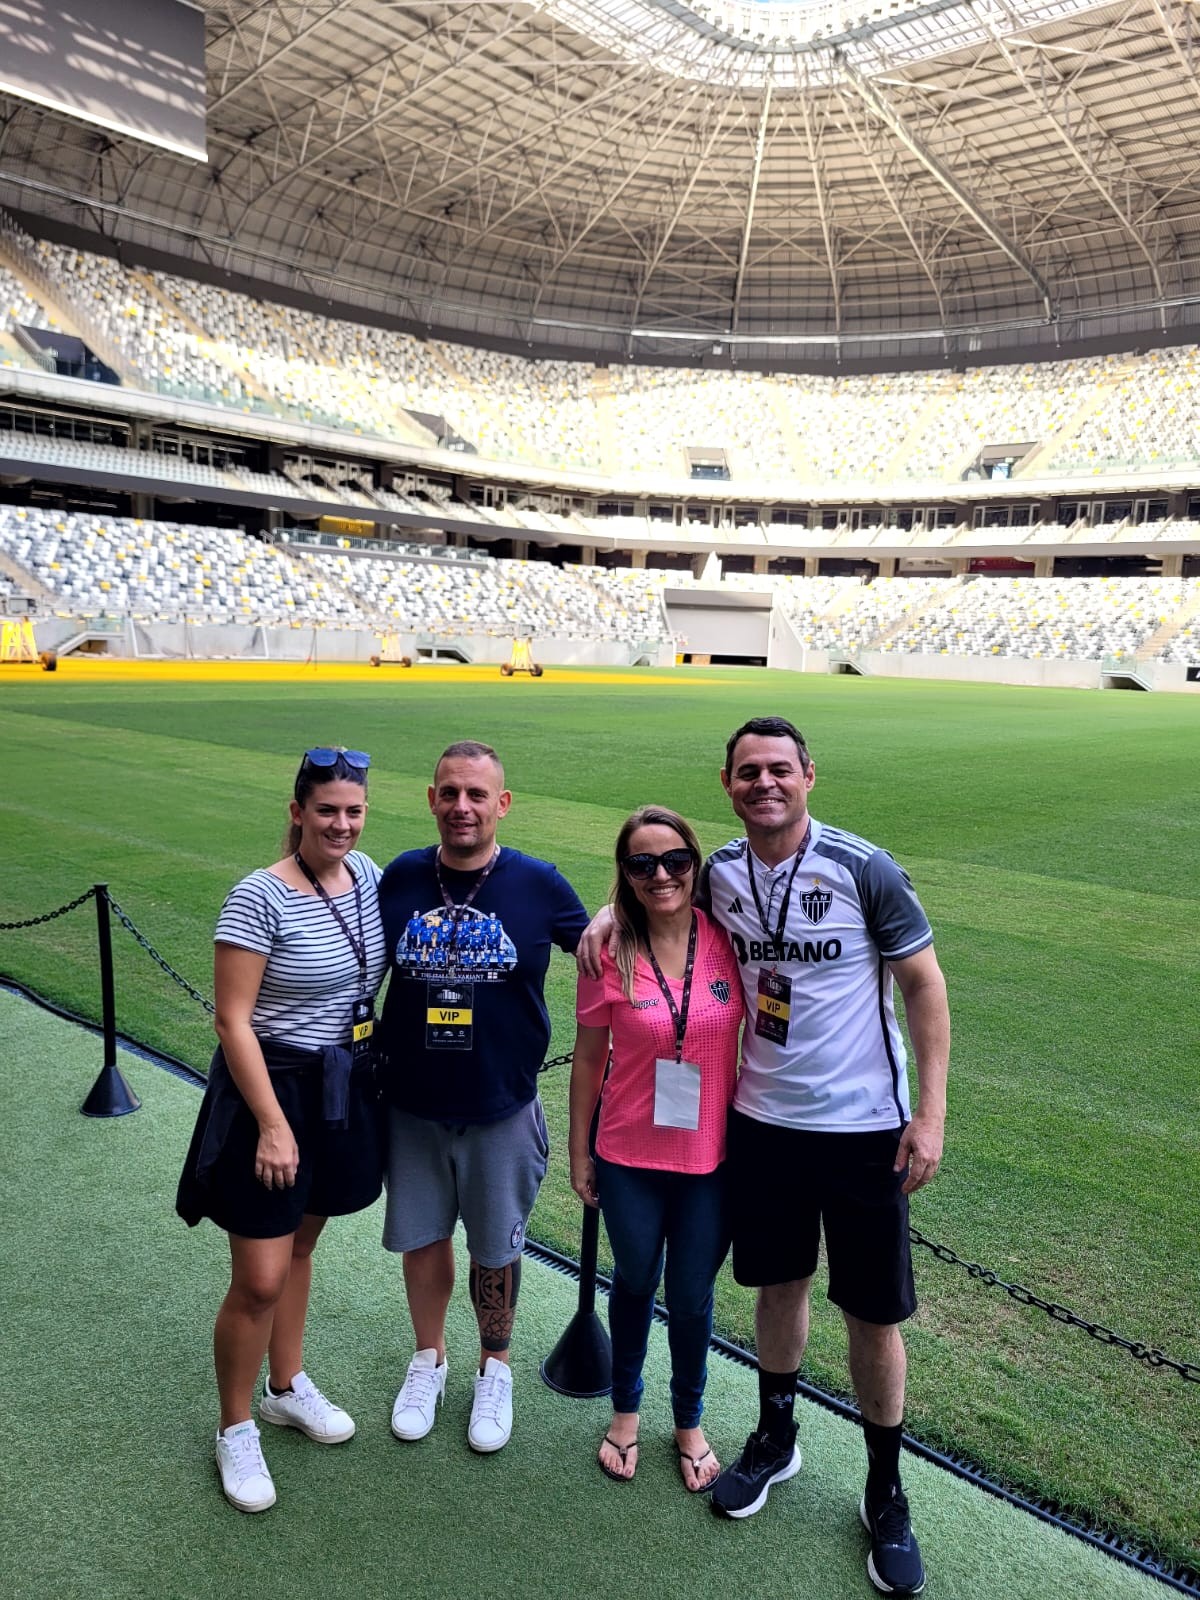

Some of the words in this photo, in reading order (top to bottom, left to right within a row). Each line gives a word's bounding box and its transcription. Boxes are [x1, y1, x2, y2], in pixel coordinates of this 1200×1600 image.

[750, 938, 842, 962] BETANO
[632, 999, 660, 1009] opper
[766, 999, 781, 1014] VIP
[439, 1011, 460, 1021] VIP
[358, 1025, 369, 1037] VIP
